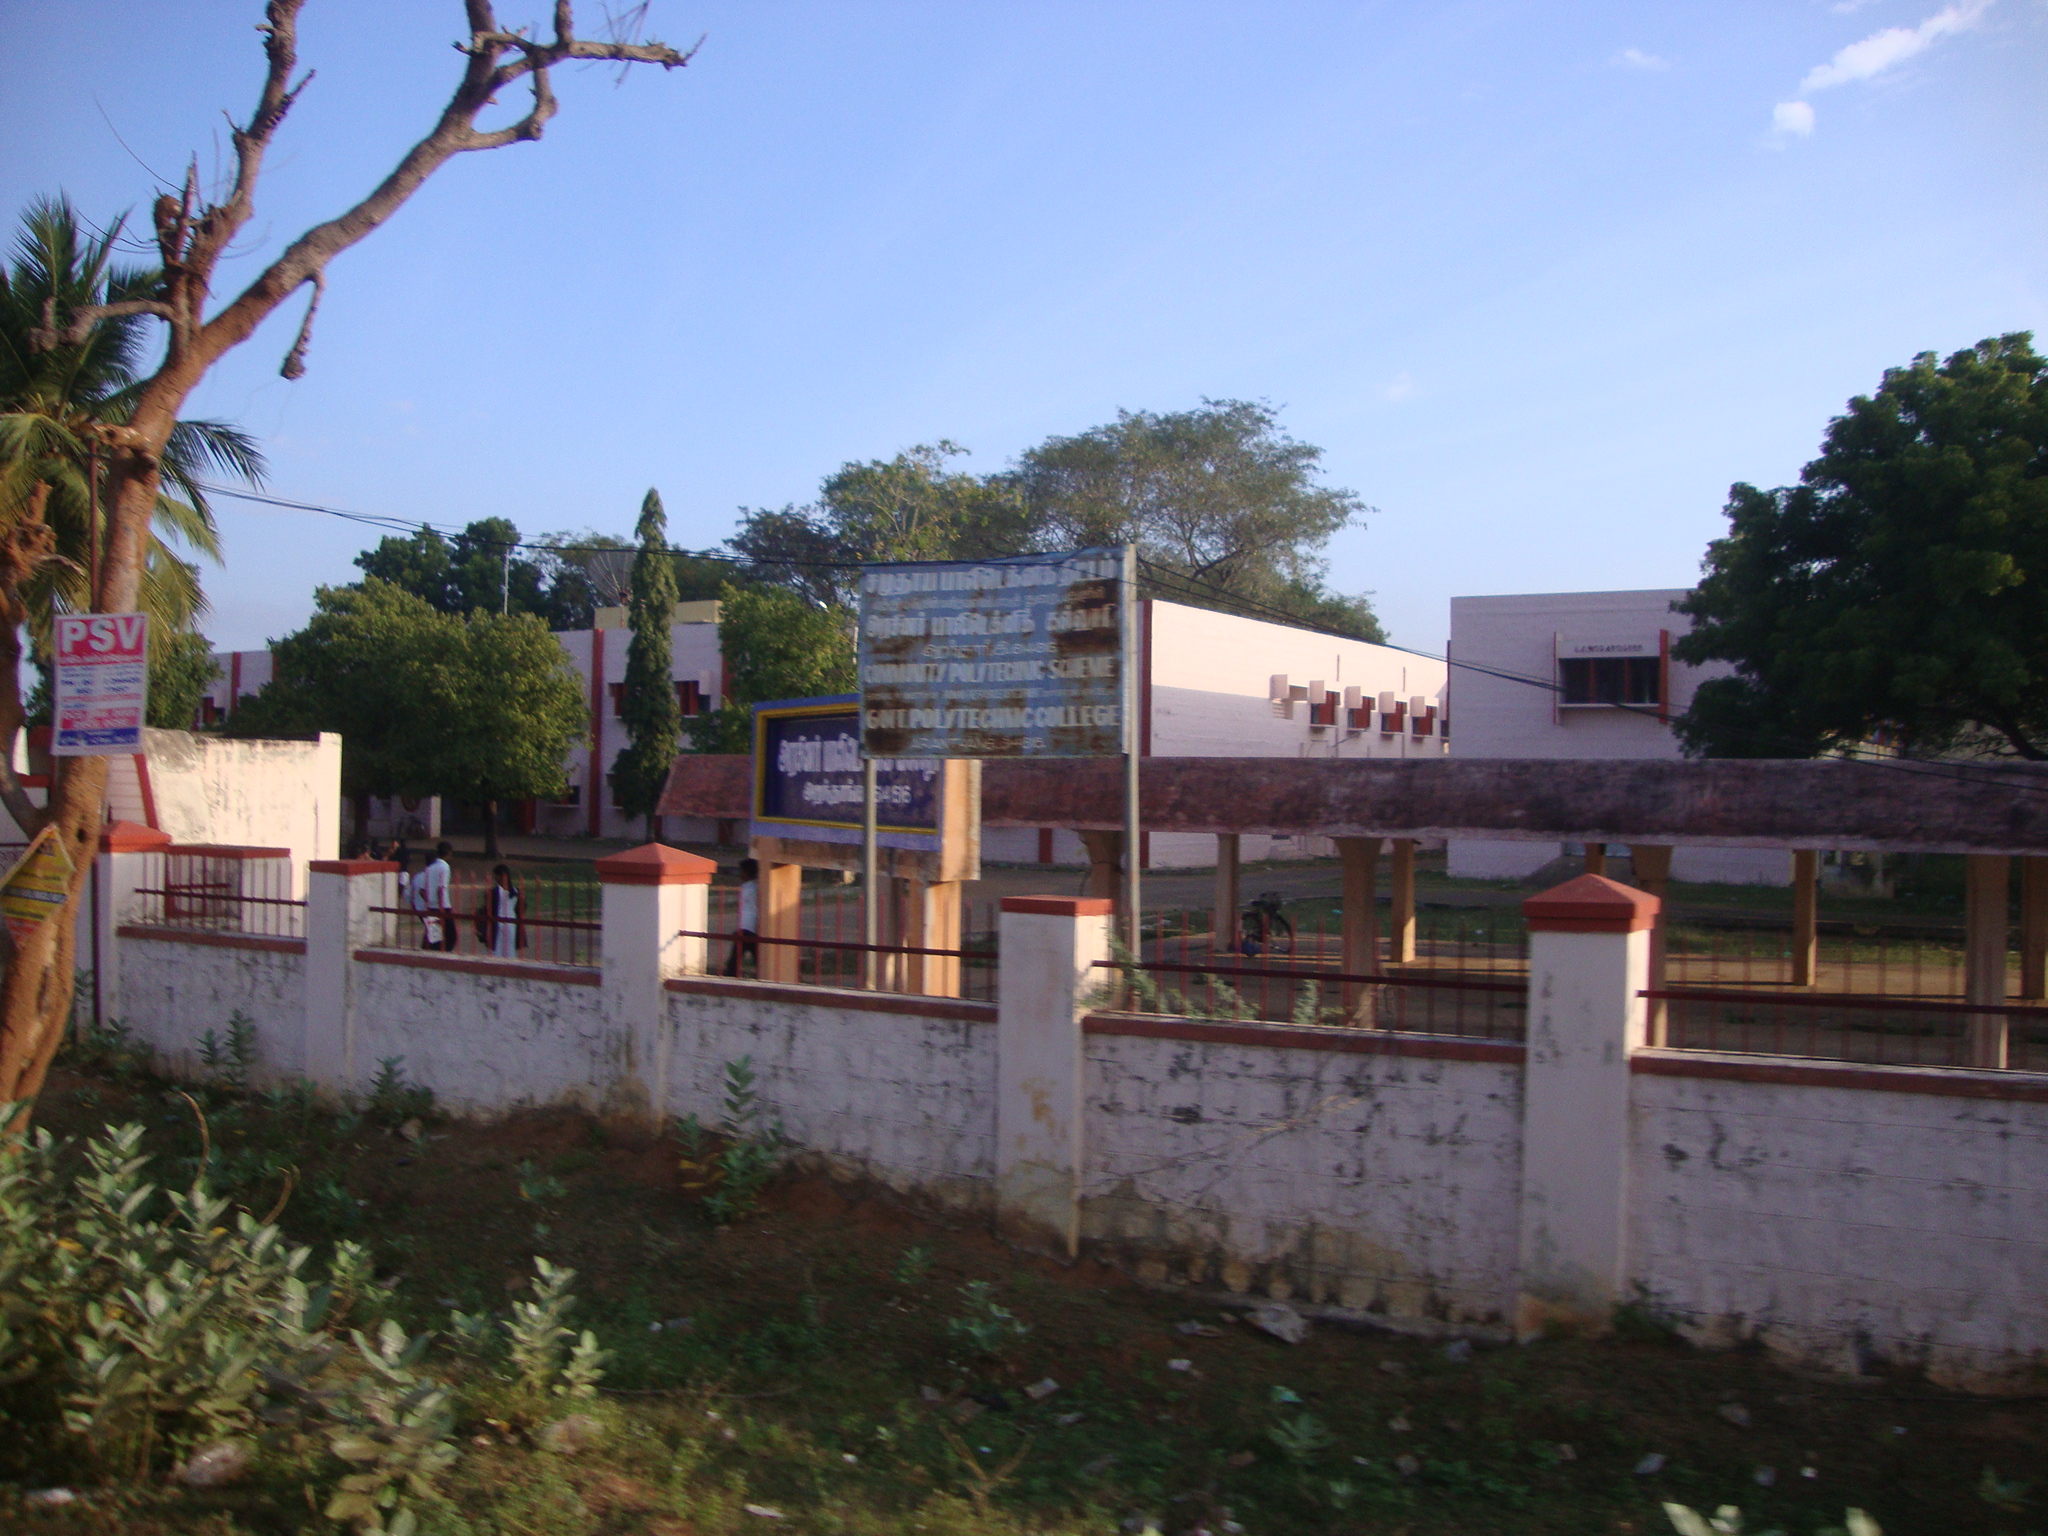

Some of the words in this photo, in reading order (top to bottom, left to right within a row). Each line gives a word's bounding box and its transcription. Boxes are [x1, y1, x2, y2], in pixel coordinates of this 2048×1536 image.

[61, 618, 142, 653] PSV
[1046, 656, 1115, 680] SCHEME
[909, 706, 1032, 730] POLYTECHNIC
[1033, 704, 1119, 728] COLLEGE
